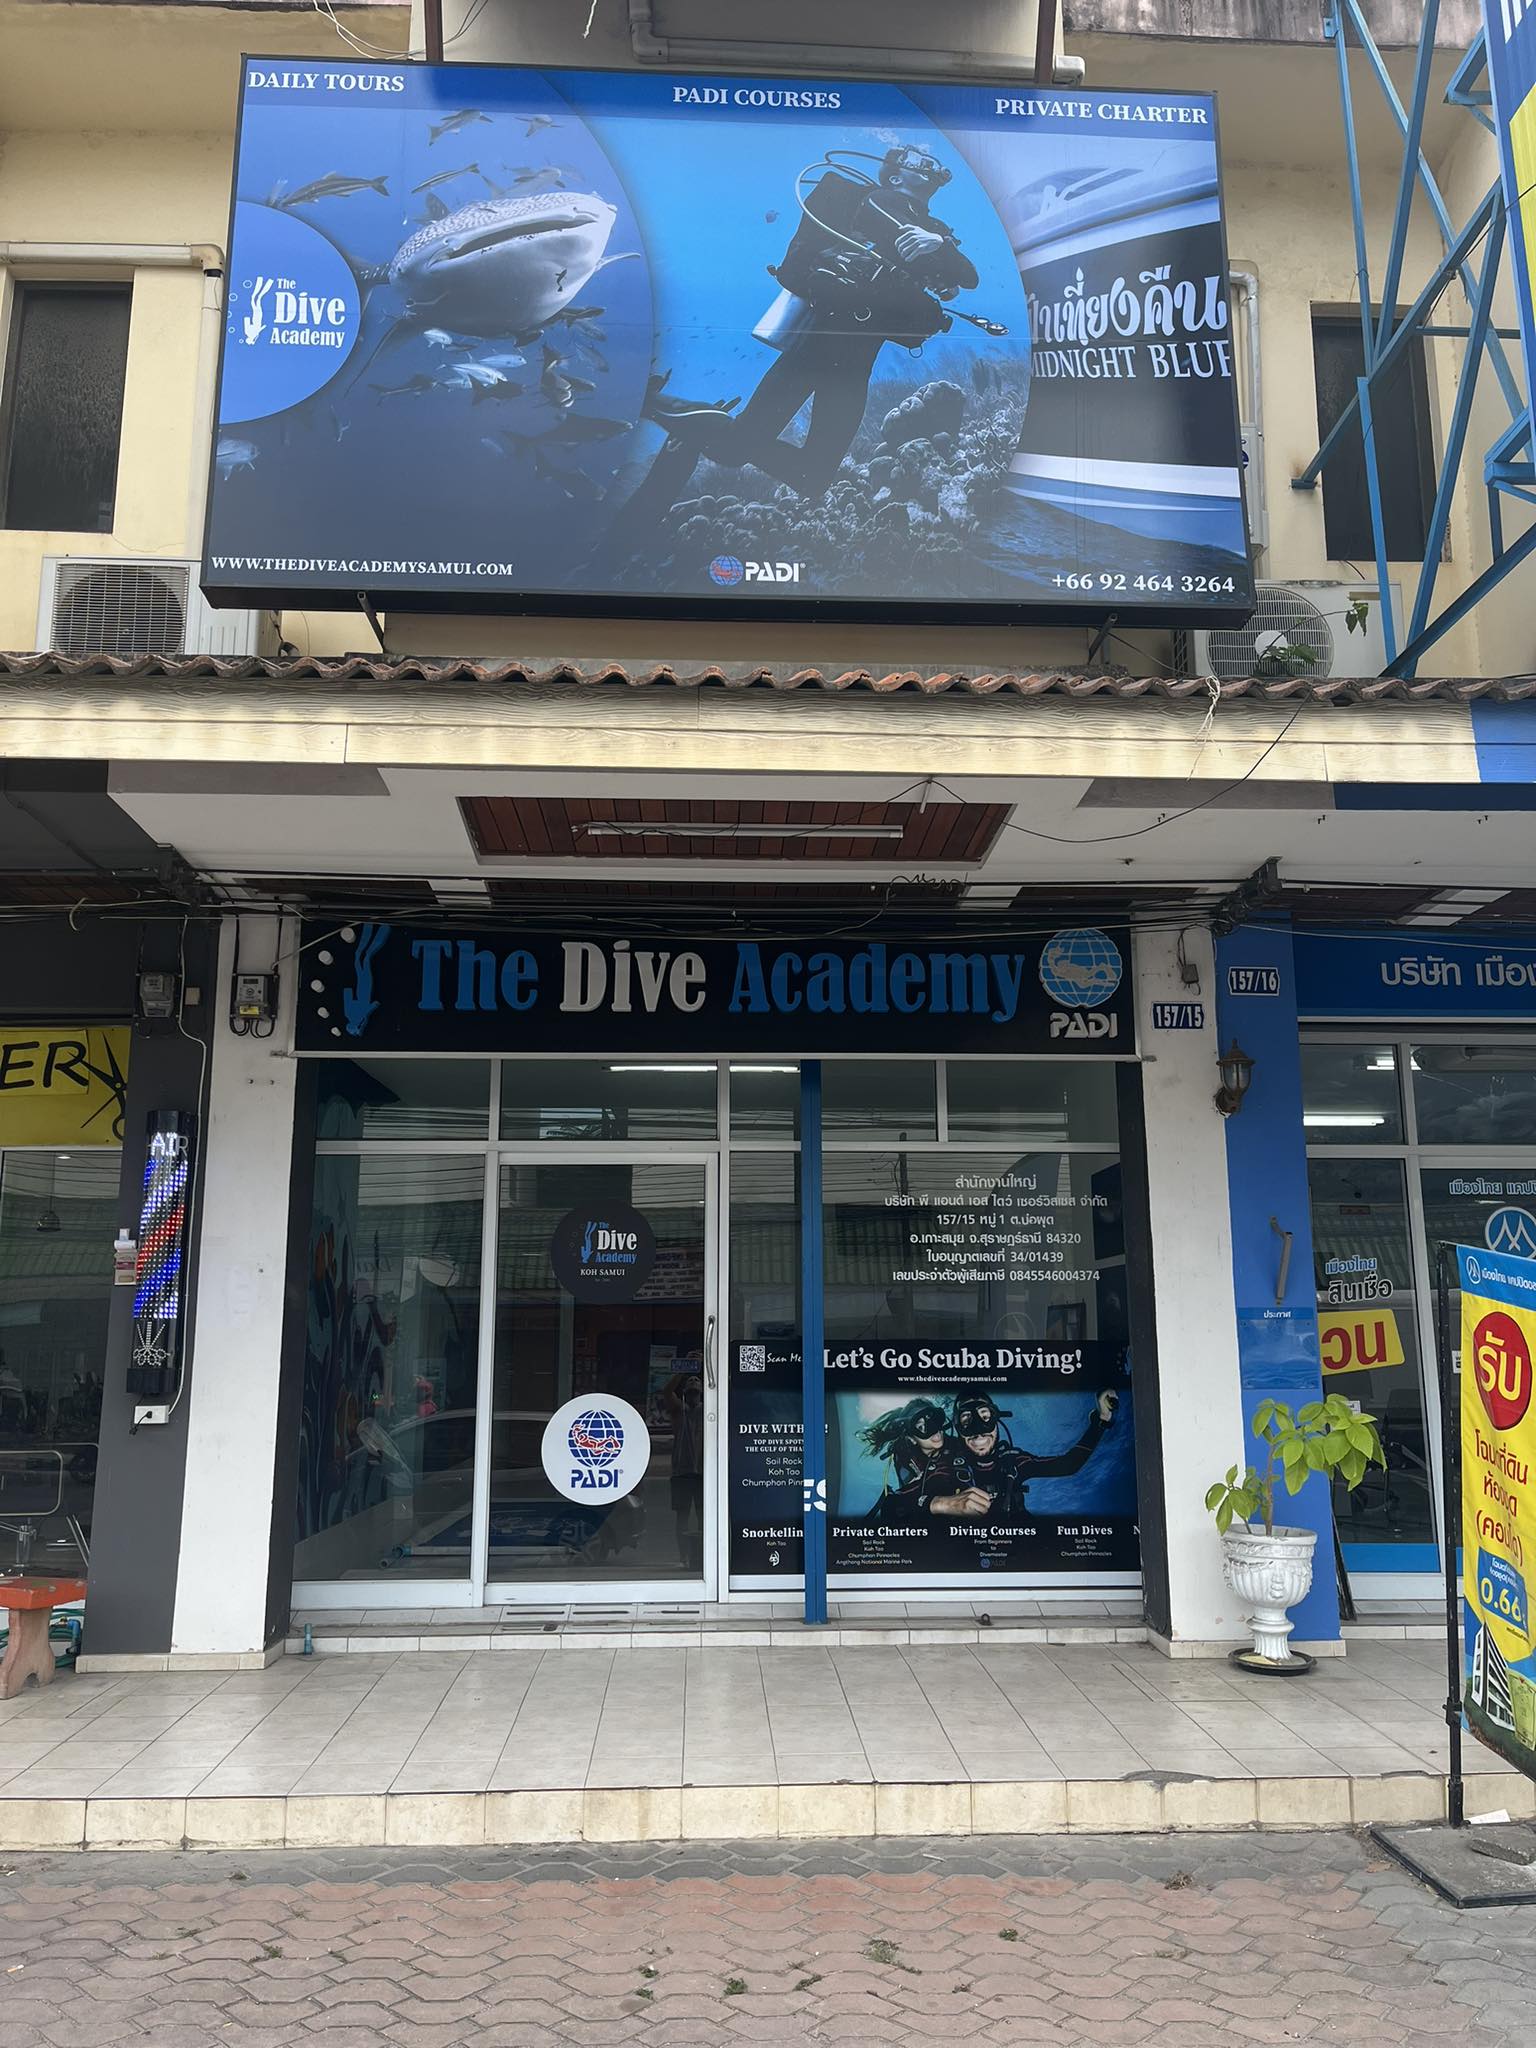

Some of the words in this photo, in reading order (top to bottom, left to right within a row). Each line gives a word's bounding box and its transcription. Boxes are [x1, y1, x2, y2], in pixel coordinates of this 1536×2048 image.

[248, 71, 320, 91] DAILY
[324, 74, 405, 93] TOURS
[673, 86, 729, 105] PADI
[734, 89, 842, 109] COURSES
[995, 98, 1092, 118] PRIVATE
[1098, 104, 1208, 125] CHARTER
[277, 278, 297, 291] The
[274, 291, 346, 326] Dive
[270, 327, 346, 348] Academy
[211, 556, 514, 577] WWW.THEDIVEACADEMYSAMUI.COM
[745, 561, 799, 582] PADI
[1052, 574, 1094, 591] +66
[1099, 574, 1128, 592] 92
[1133, 574, 1174, 593] 464
[1180, 576, 1236, 593] 3264
[1380, 955, 1462, 986] บริษัท
[411, 939, 539, 1011] The
[560, 940, 706, 1013] Dive
[728, 943, 1025, 1023] Academy
[1232, 967, 1279, 994] 157/16
[1155, 1004, 1202, 1028] 157/15
[1049, 1012, 1118, 1040] PADI
[955, 1174, 1037, 1190] สำนักงานใหญ่
[1449, 1178, 1503, 1195] เมืองไทย
[884, 1194, 915, 1207] บริษัท
[919, 1194, 929, 1206] พี
[934, 1195, 964, 1206] แอนด์
[969, 1195, 989, 1206] เอส
[1080, 1194, 1108, 1207] จำกัด
[937, 1214, 976, 1225] 157/15
[980, 1213, 997, 1228] หมู่
[1000, 1215, 1005, 1225] 1
[597, 1229, 637, 1251] Dive
[910, 1234, 965, 1246] อ.เกาะสมุย
[1046, 1233, 1082, 1244] 84320
[595, 1252, 637, 1264] Academy
[926, 1248, 1006, 1264] ใบอนุญาตเลขที่
[1010, 1252, 1064, 1262] 34/01439
[1326, 1255, 1377, 1275] เมืองไทย
[1009, 1270, 1101, 1281] 0845546004374
[1329, 1273, 1393, 1304] สินเชื่อ
[1264, 1310, 1292, 1318] ประกาศ
[1321, 1321, 1388, 1370] วน
[767, 1353, 787, 1362] Scan
[790, 1353, 802, 1362] Me
[880, 1349, 912, 1368] Go
[918, 1348, 991, 1369] Scuba
[996, 1348, 1083, 1374] Diving!
[1477, 1331, 1522, 1401] รับ
[898, 1375, 1008, 1383] www.thediveacademysamui.com
[739, 1424, 768, 1433] DIVE
[772, 1424, 804, 1433] WITH
[571, 1470, 618, 1487] PADI
[742, 1479, 786, 1488] Chumphon
[742, 1528, 803, 1538] Snorkellin
[833, 1527, 875, 1537] Private
[877, 1527, 928, 1537] Charters
[950, 1526, 987, 1538] Diving
[991, 1526, 1036, 1536] Courses
[1057, 1525, 1079, 1535] Fun
[1082, 1525, 1113, 1535] Dives
[1481, 1577, 1522, 1622] 0.66
